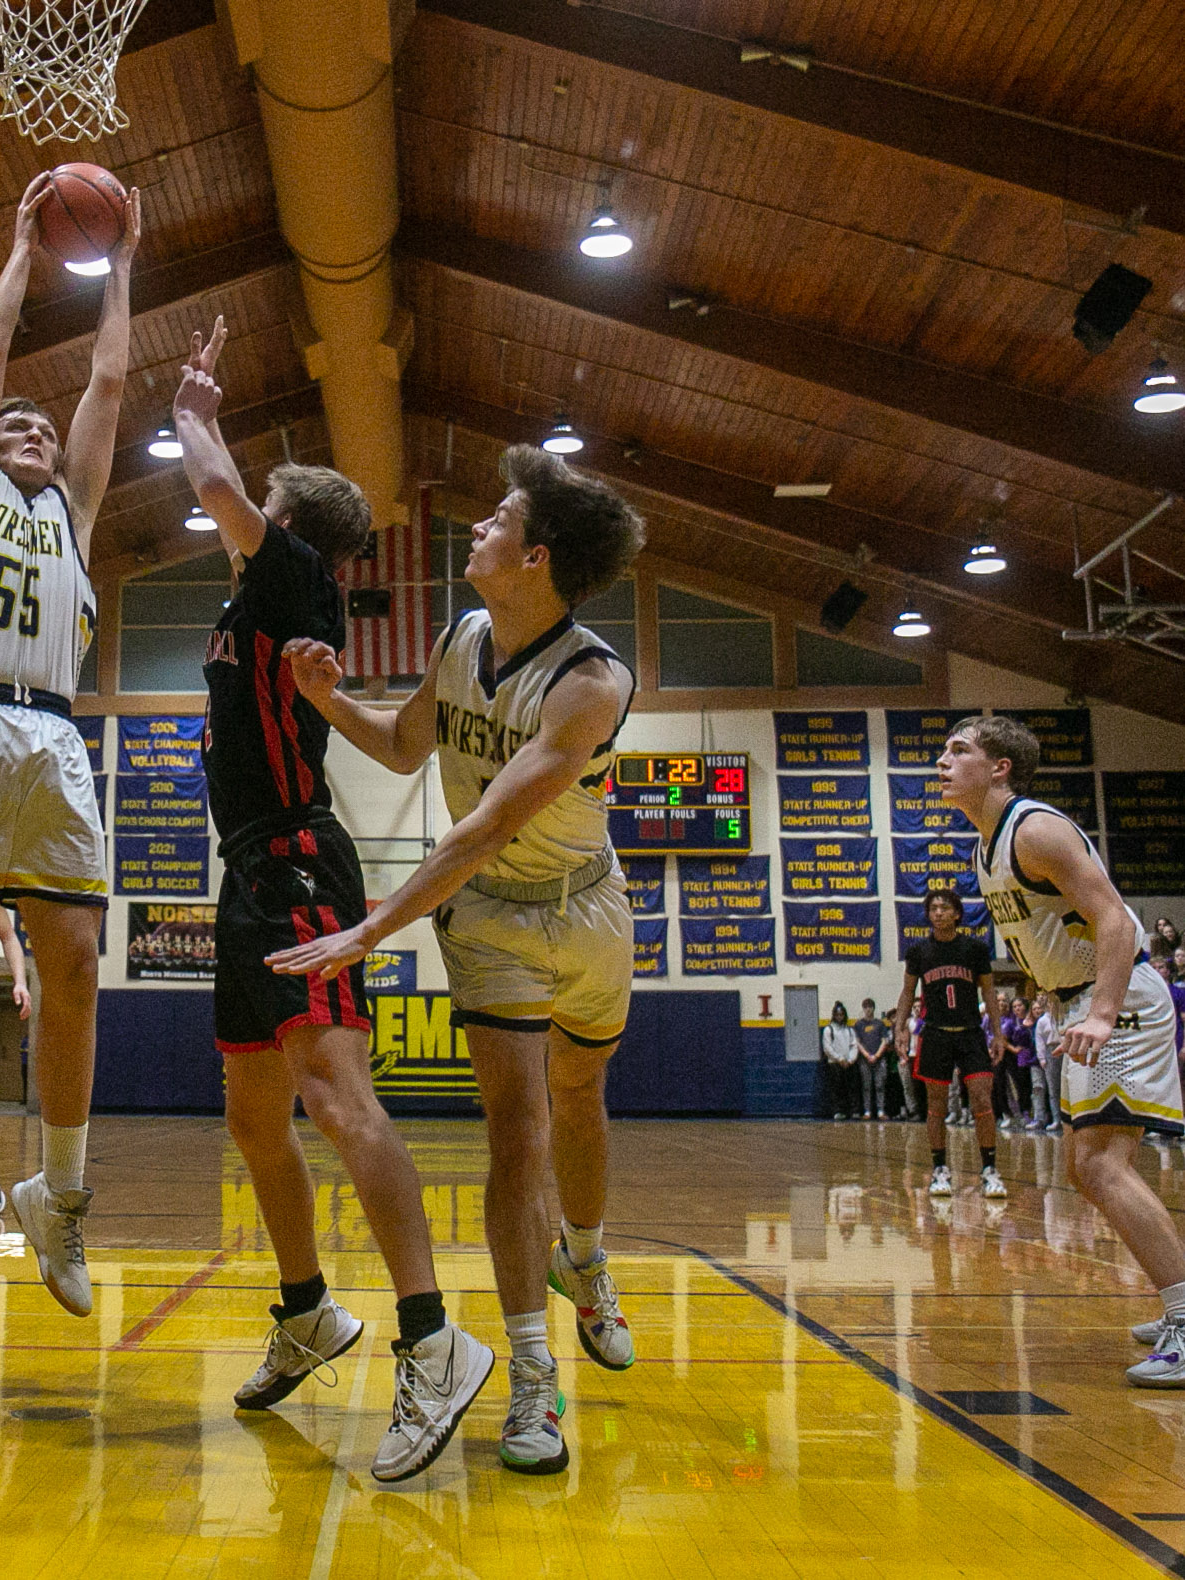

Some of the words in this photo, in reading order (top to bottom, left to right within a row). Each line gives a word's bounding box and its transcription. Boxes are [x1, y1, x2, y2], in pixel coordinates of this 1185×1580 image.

[780, 734, 807, 743] STATE
[124, 740, 150, 750] STATE
[154, 740, 202, 750] CHAMPIONS
[130, 755, 195, 767] VOLLEYBALL
[706, 756, 746, 767] VISITOR
[785, 751, 816, 762] GIRLS
[822, 749, 861, 760] TENNIS
[898, 751, 930, 762] GIRLS
[647, 759, 697, 782] 1:22
[715, 768, 744, 792] 28
[148, 782, 174, 793] 2010
[924, 781, 943, 792] 199
[639, 794, 666, 804] PERIOD
[669, 786, 682, 805] 2
[706, 794, 734, 804] BONUS
[121, 800, 146, 809] STATE
[151, 800, 201, 809] CHAMPIONS
[783, 799, 811, 809] STATE
[813, 799, 868, 809] RUNNER-UP
[896, 799, 923, 809] STATE
[634, 809, 665, 819] PLAYER
[670, 809, 696, 819] FOULS
[715, 809, 741, 818] FOULS
[138, 816, 166, 826] CROSS
[167, 817, 205, 827] COUNTRY
[782, 815, 839, 826] COMPETITIVE
[841, 815, 870, 825] CHEER
[924, 815, 952, 827] GOLF
[727, 819, 741, 839] 5
[148, 843, 175, 855] 2021
[121, 861, 148, 871] STATE
[151, 861, 202, 871] CHAMPIONS
[787, 861, 814, 872] STATE
[817, 861, 872, 872] RUNNER-UP
[899, 862, 927, 872] STATE
[122, 877, 153, 889] GIRLS
[157, 878, 200, 889] SOCCER
[682, 881, 710, 892] STATE
[713, 880, 767, 891] RUNNER-UP
[791, 878, 823, 889] GIRLS
[829, 877, 868, 889] TENNIS
[927, 878, 957, 890] GOLF
[688, 896, 718, 909] BOYS
[721, 896, 762, 908] TENNIS
[147, 905, 217, 923] NORSE
[715, 925, 740, 937] 1994
[791, 926, 817, 937] STATE
[819, 926, 875, 937] RUNNER-UP
[903, 927, 930, 937] STATE
[686, 943, 714, 954] STATE
[715, 941, 770, 953] RUNNER-UP
[795, 943, 824, 955] BOYS
[831, 942, 871, 955] TENNIS
[365, 952, 402, 966] ORSE
[685, 958, 743, 970] COMPETITIVE
[745, 957, 774, 968] CHEER
[633, 960, 659, 971] NNIS
[365, 975, 400, 987] RIDE
[946, 984, 956, 1009] 1
